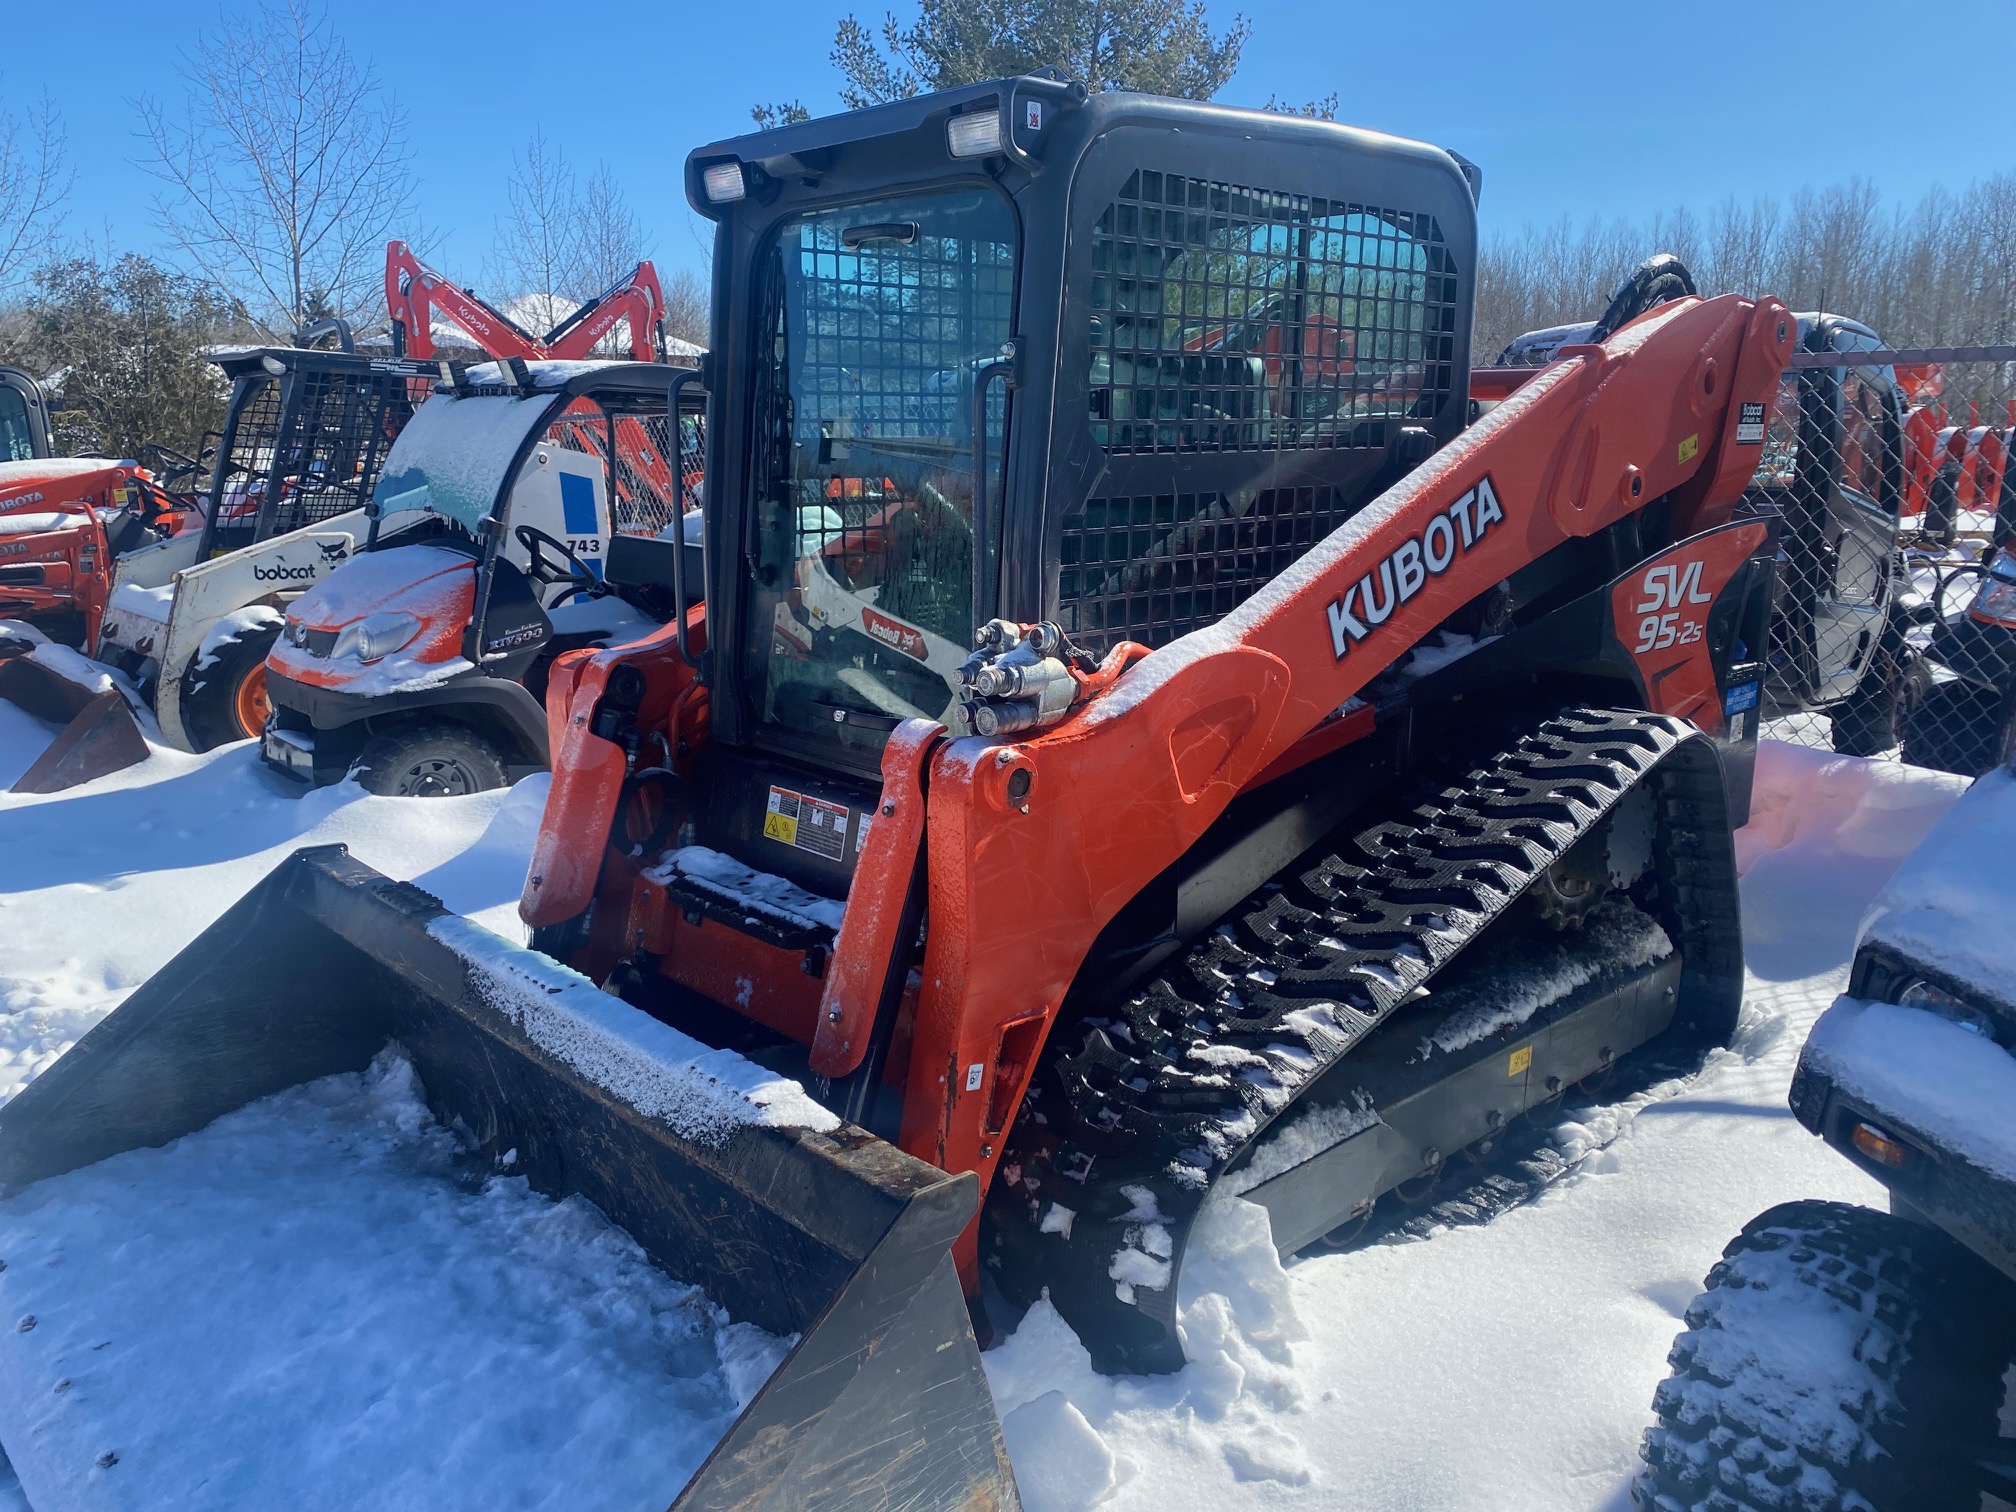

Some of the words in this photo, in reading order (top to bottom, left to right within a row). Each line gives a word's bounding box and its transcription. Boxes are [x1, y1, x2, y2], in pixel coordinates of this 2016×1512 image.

[458, 305, 490, 336] Kubota
[588, 314, 614, 336] Kubota
[1743, 403, 1763, 416] Bobcat
[0, 491, 45, 513] UBOTA
[0, 542, 29, 557] OTA
[566, 539, 600, 553] 743
[254, 564, 316, 581] bobcat
[1326, 476, 1504, 660] KUBOTA
[1637, 561, 1712, 614] SVL
